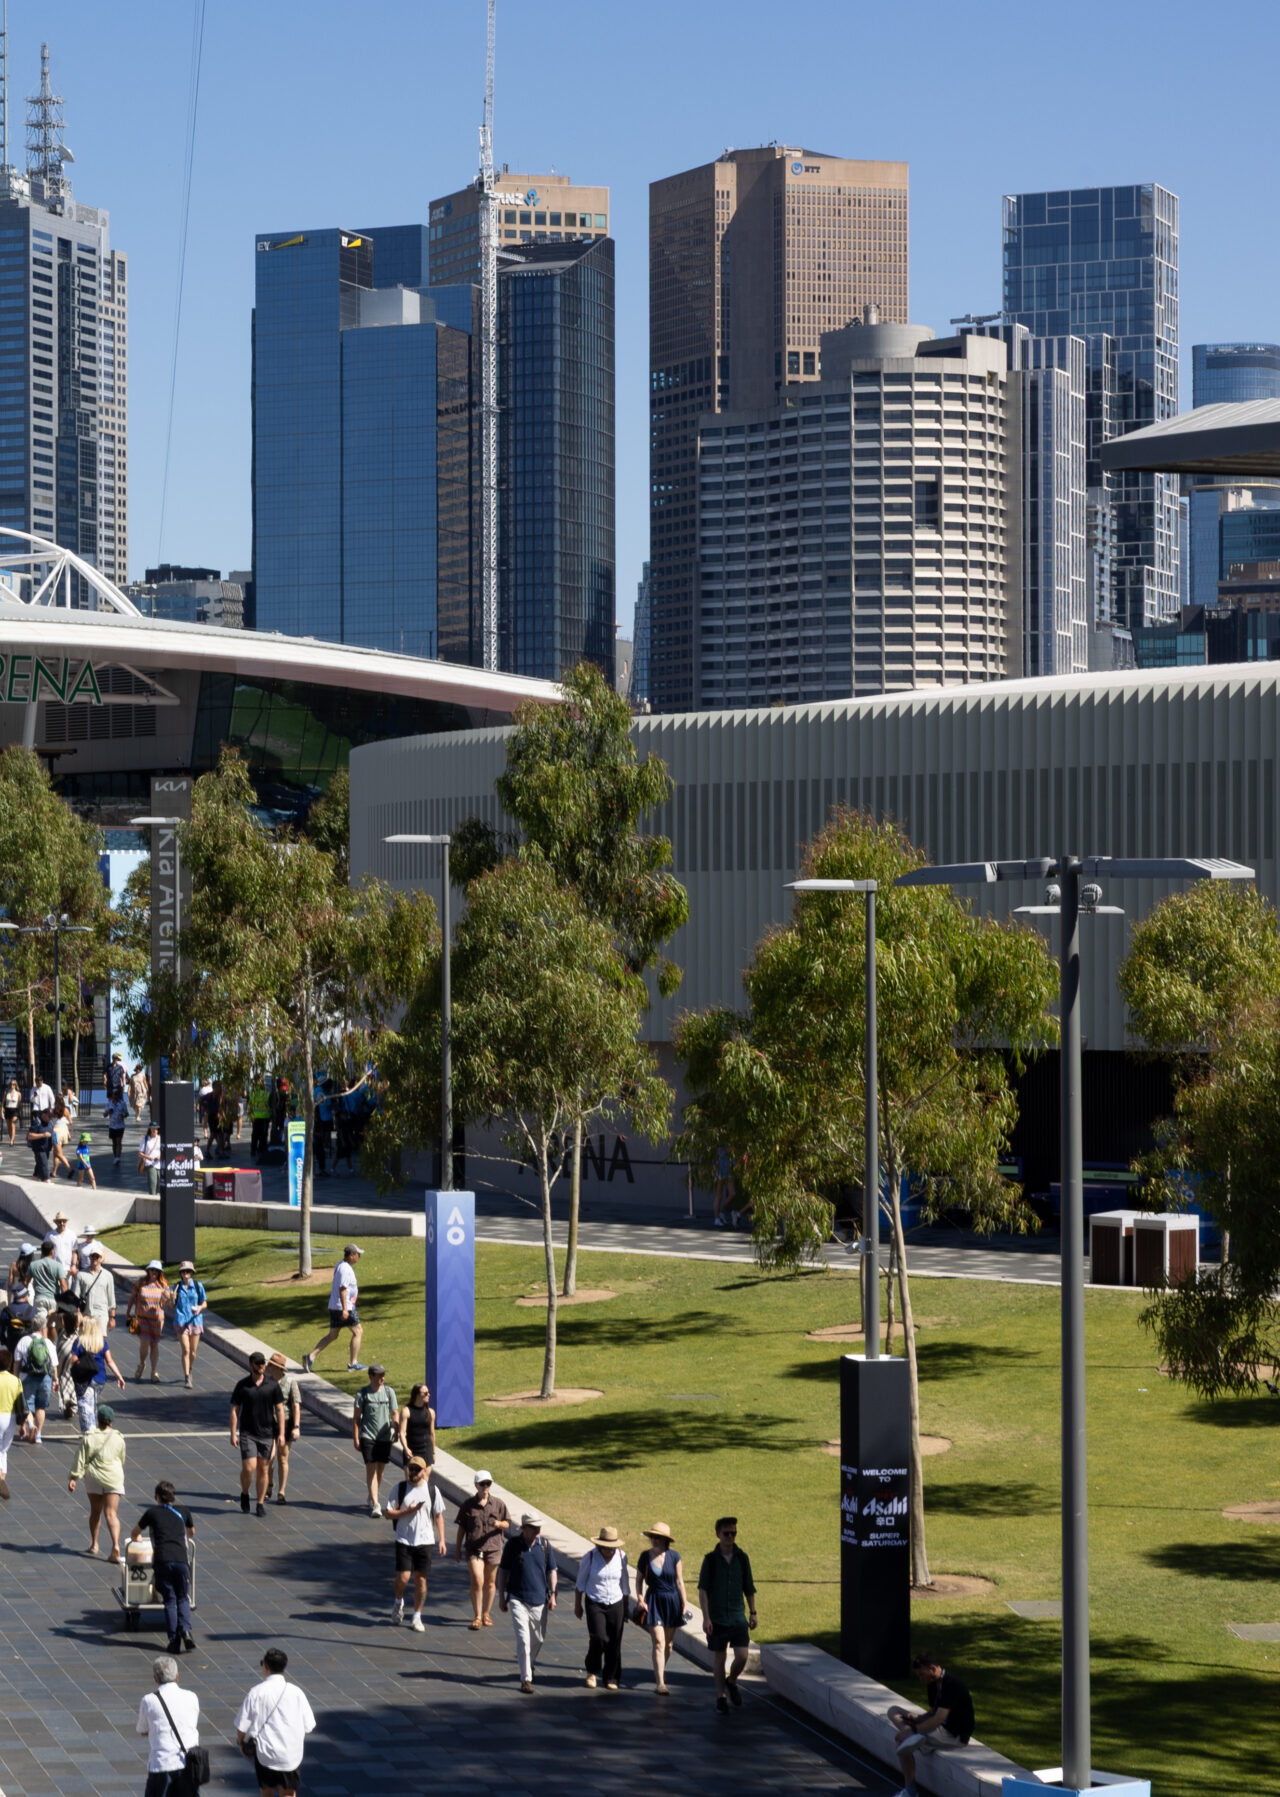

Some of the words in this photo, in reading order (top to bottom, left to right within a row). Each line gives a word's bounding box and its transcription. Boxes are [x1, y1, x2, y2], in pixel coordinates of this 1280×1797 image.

[257, 241, 271, 251] EY
[155, 781, 187, 791] KIA
[167, 1159, 193, 1171] Asahi
[862, 1468, 907, 1476] WELCOME
[862, 1496, 907, 1516] Asahi
[869, 1532, 900, 1540] SUPER
